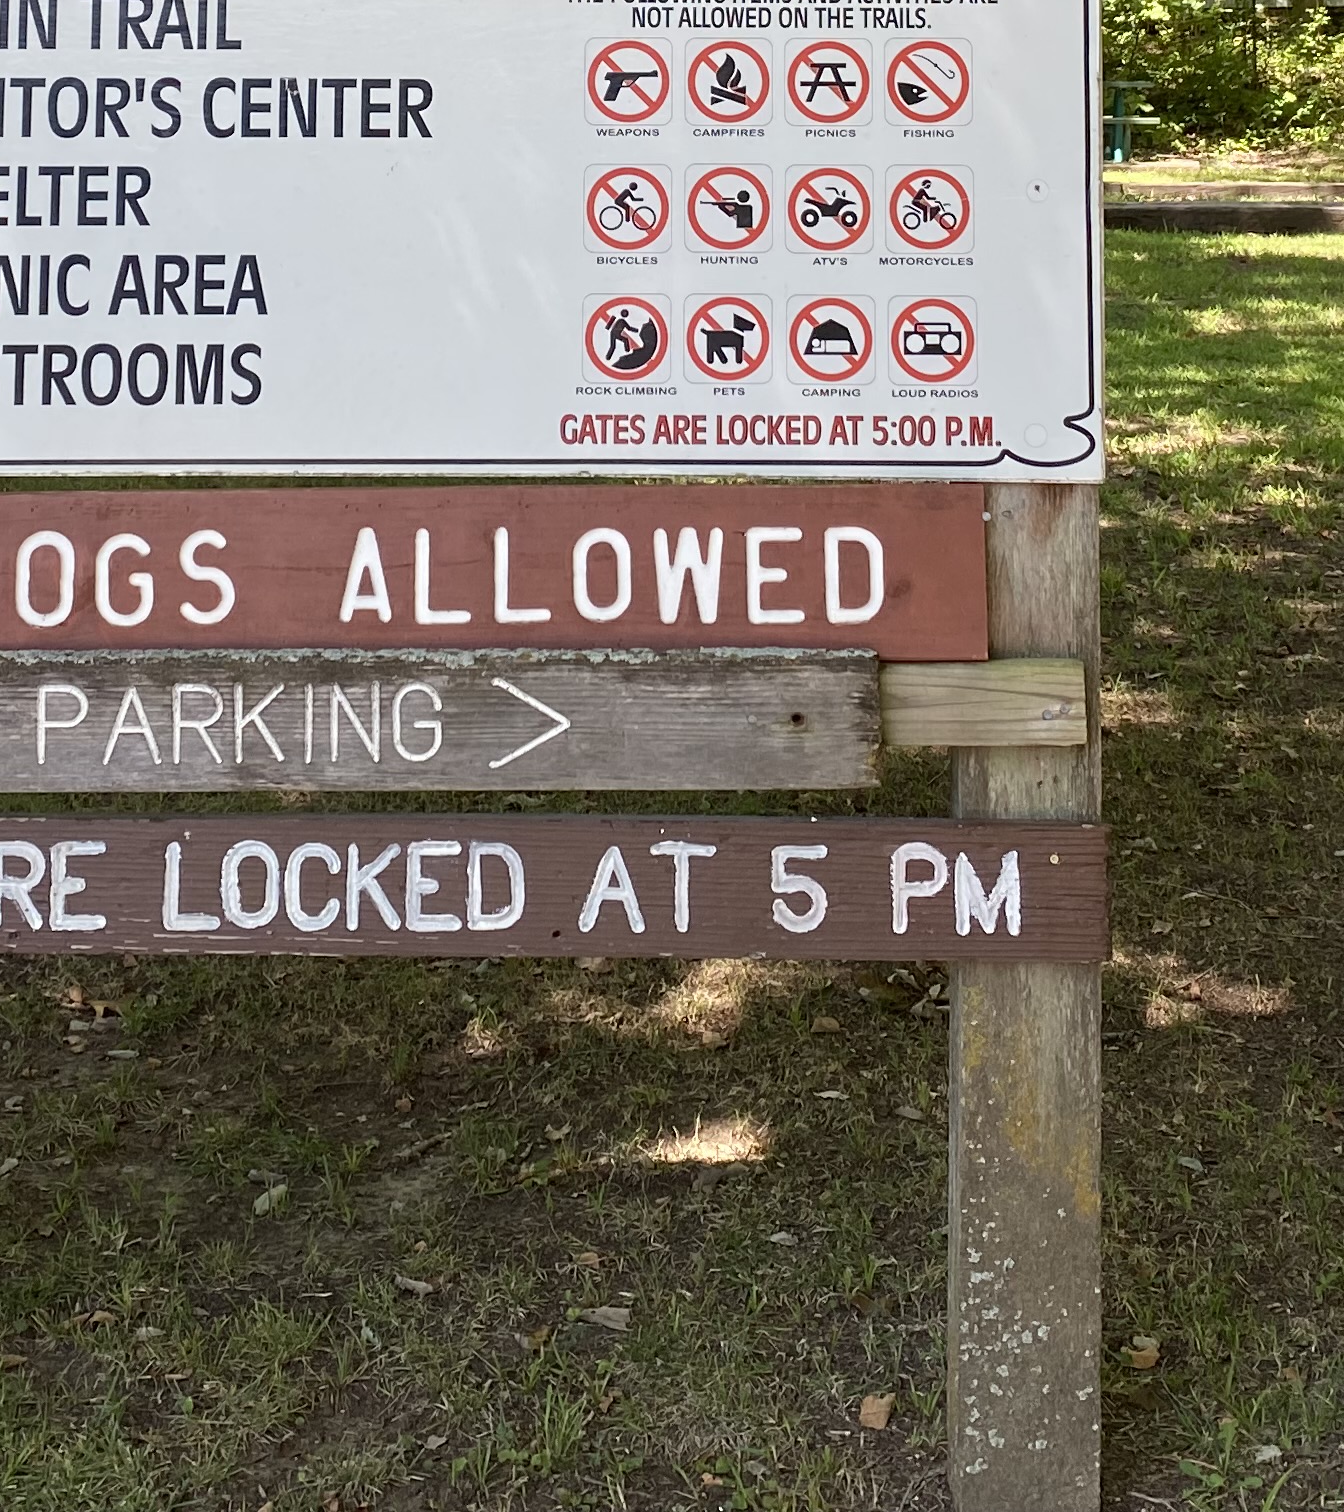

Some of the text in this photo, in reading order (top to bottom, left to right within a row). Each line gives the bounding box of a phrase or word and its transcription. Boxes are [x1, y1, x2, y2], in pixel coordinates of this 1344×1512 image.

[631, 6, 932, 29] NOT ALLOWED ON THE TRAILS.
[202, 77, 433, 139] CENTER
[596, 128, 660, 137] WEAPONS
[692, 128, 765, 137] CAMPFIRES
[805, 129, 857, 138] PICNICS
[903, 129, 955, 138] FISHING
[596, 256, 658, 265] BICYCLES
[700, 255, 759, 265] HUNTING
[812, 257, 848, 266] ATV'S
[879, 257, 974, 266] MOTORCYCLES
[107, 254, 268, 316] AREA
[575, 386, 677, 396] ROCK CLIMBING
[713, 387, 746, 396] PETS
[801, 388, 861, 397] CAMPING
[891, 389, 979, 399] LOUD RADIOS
[559, 413, 1002, 447] GATES ARE LOCKED AT 5:00 P.M.
[338, 525, 886, 626] ALLOWED
[35, 680, 443, 766] PARKING
[162, 839, 527, 933] LOCKED
[578, 840, 717, 934] AT
[770, 844, 828, 934] 5
[889, 841, 1022, 937] PM
